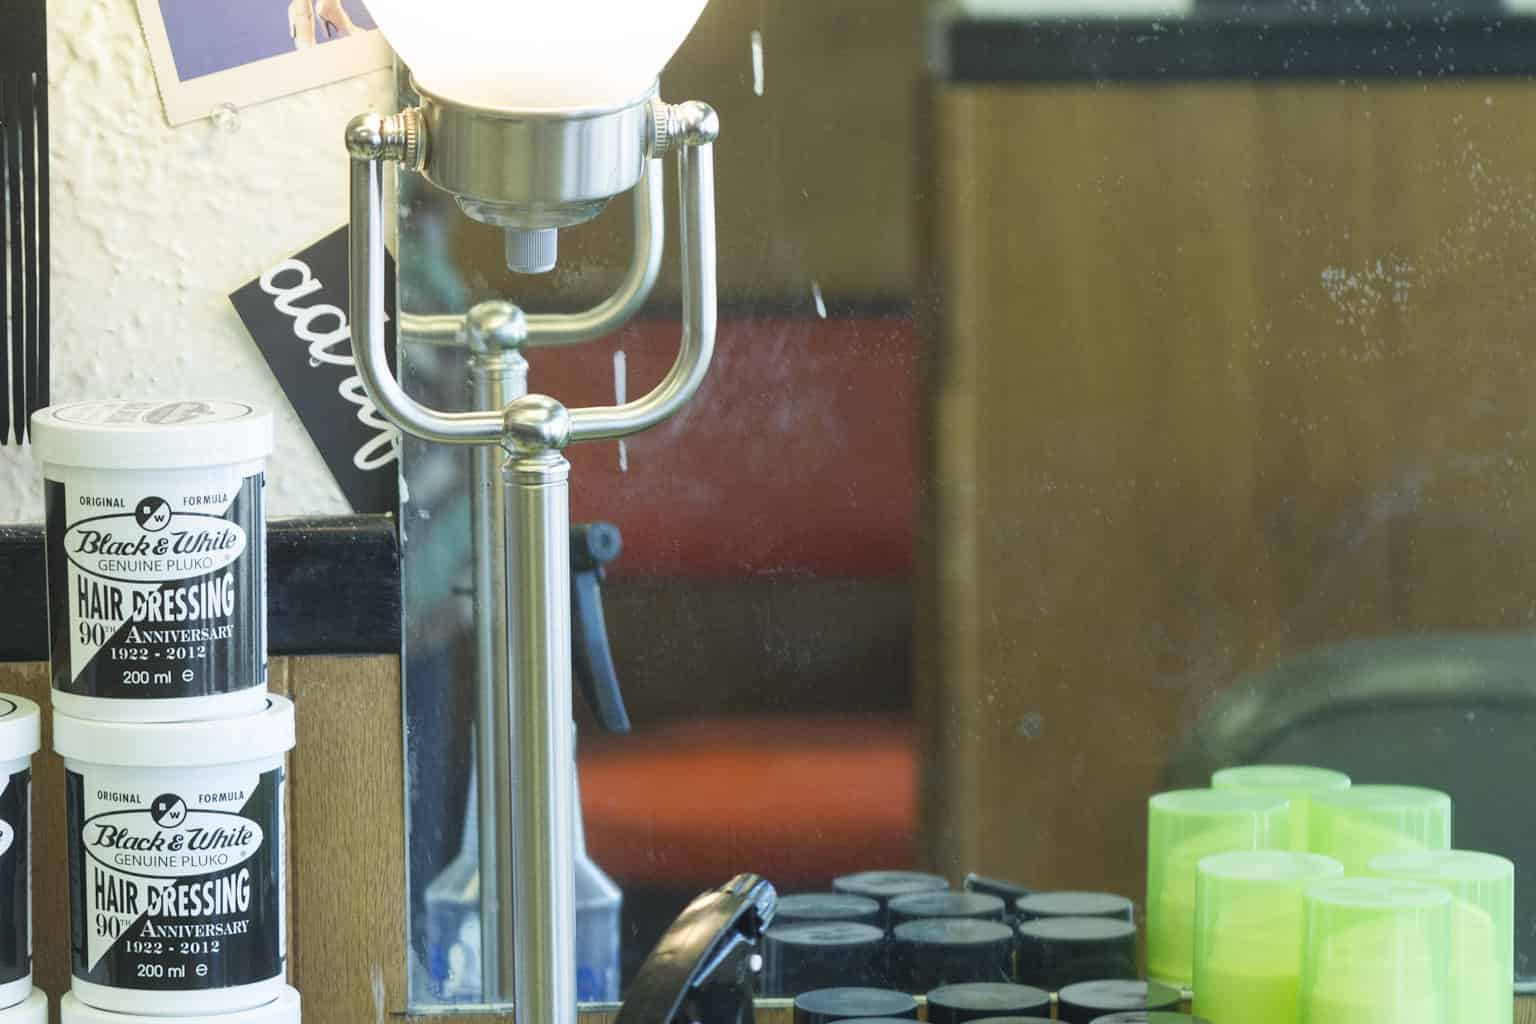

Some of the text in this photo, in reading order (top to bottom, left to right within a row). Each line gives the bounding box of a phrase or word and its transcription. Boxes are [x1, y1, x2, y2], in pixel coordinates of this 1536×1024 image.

[79, 496, 125, 508] ORIGINAL
[183, 493, 228, 506] FORMULA
[75, 530, 149, 555] Black
[170, 528, 236, 554] White
[98, 557, 213, 572] GENUINE PLUKO
[77, 572, 234, 622] HAIR DRESSING
[111, 647, 206, 660] 1922 2012
[123, 671, 149, 684] 200
[154, 671, 171, 684] ml
[98, 791, 141, 804] ORIGINAL
[199, 791, 244, 804] FORMULA
[92, 824, 164, 852] Black
[186, 825, 252, 850] White
[114, 854, 228, 868] GENUINE PLUKO
[95, 866, 250, 916] HAIR DRESSING
[126, 940, 219, 952] 1922 2012
[137, 964, 163, 978] 200
[168, 964, 184, 977] ml
